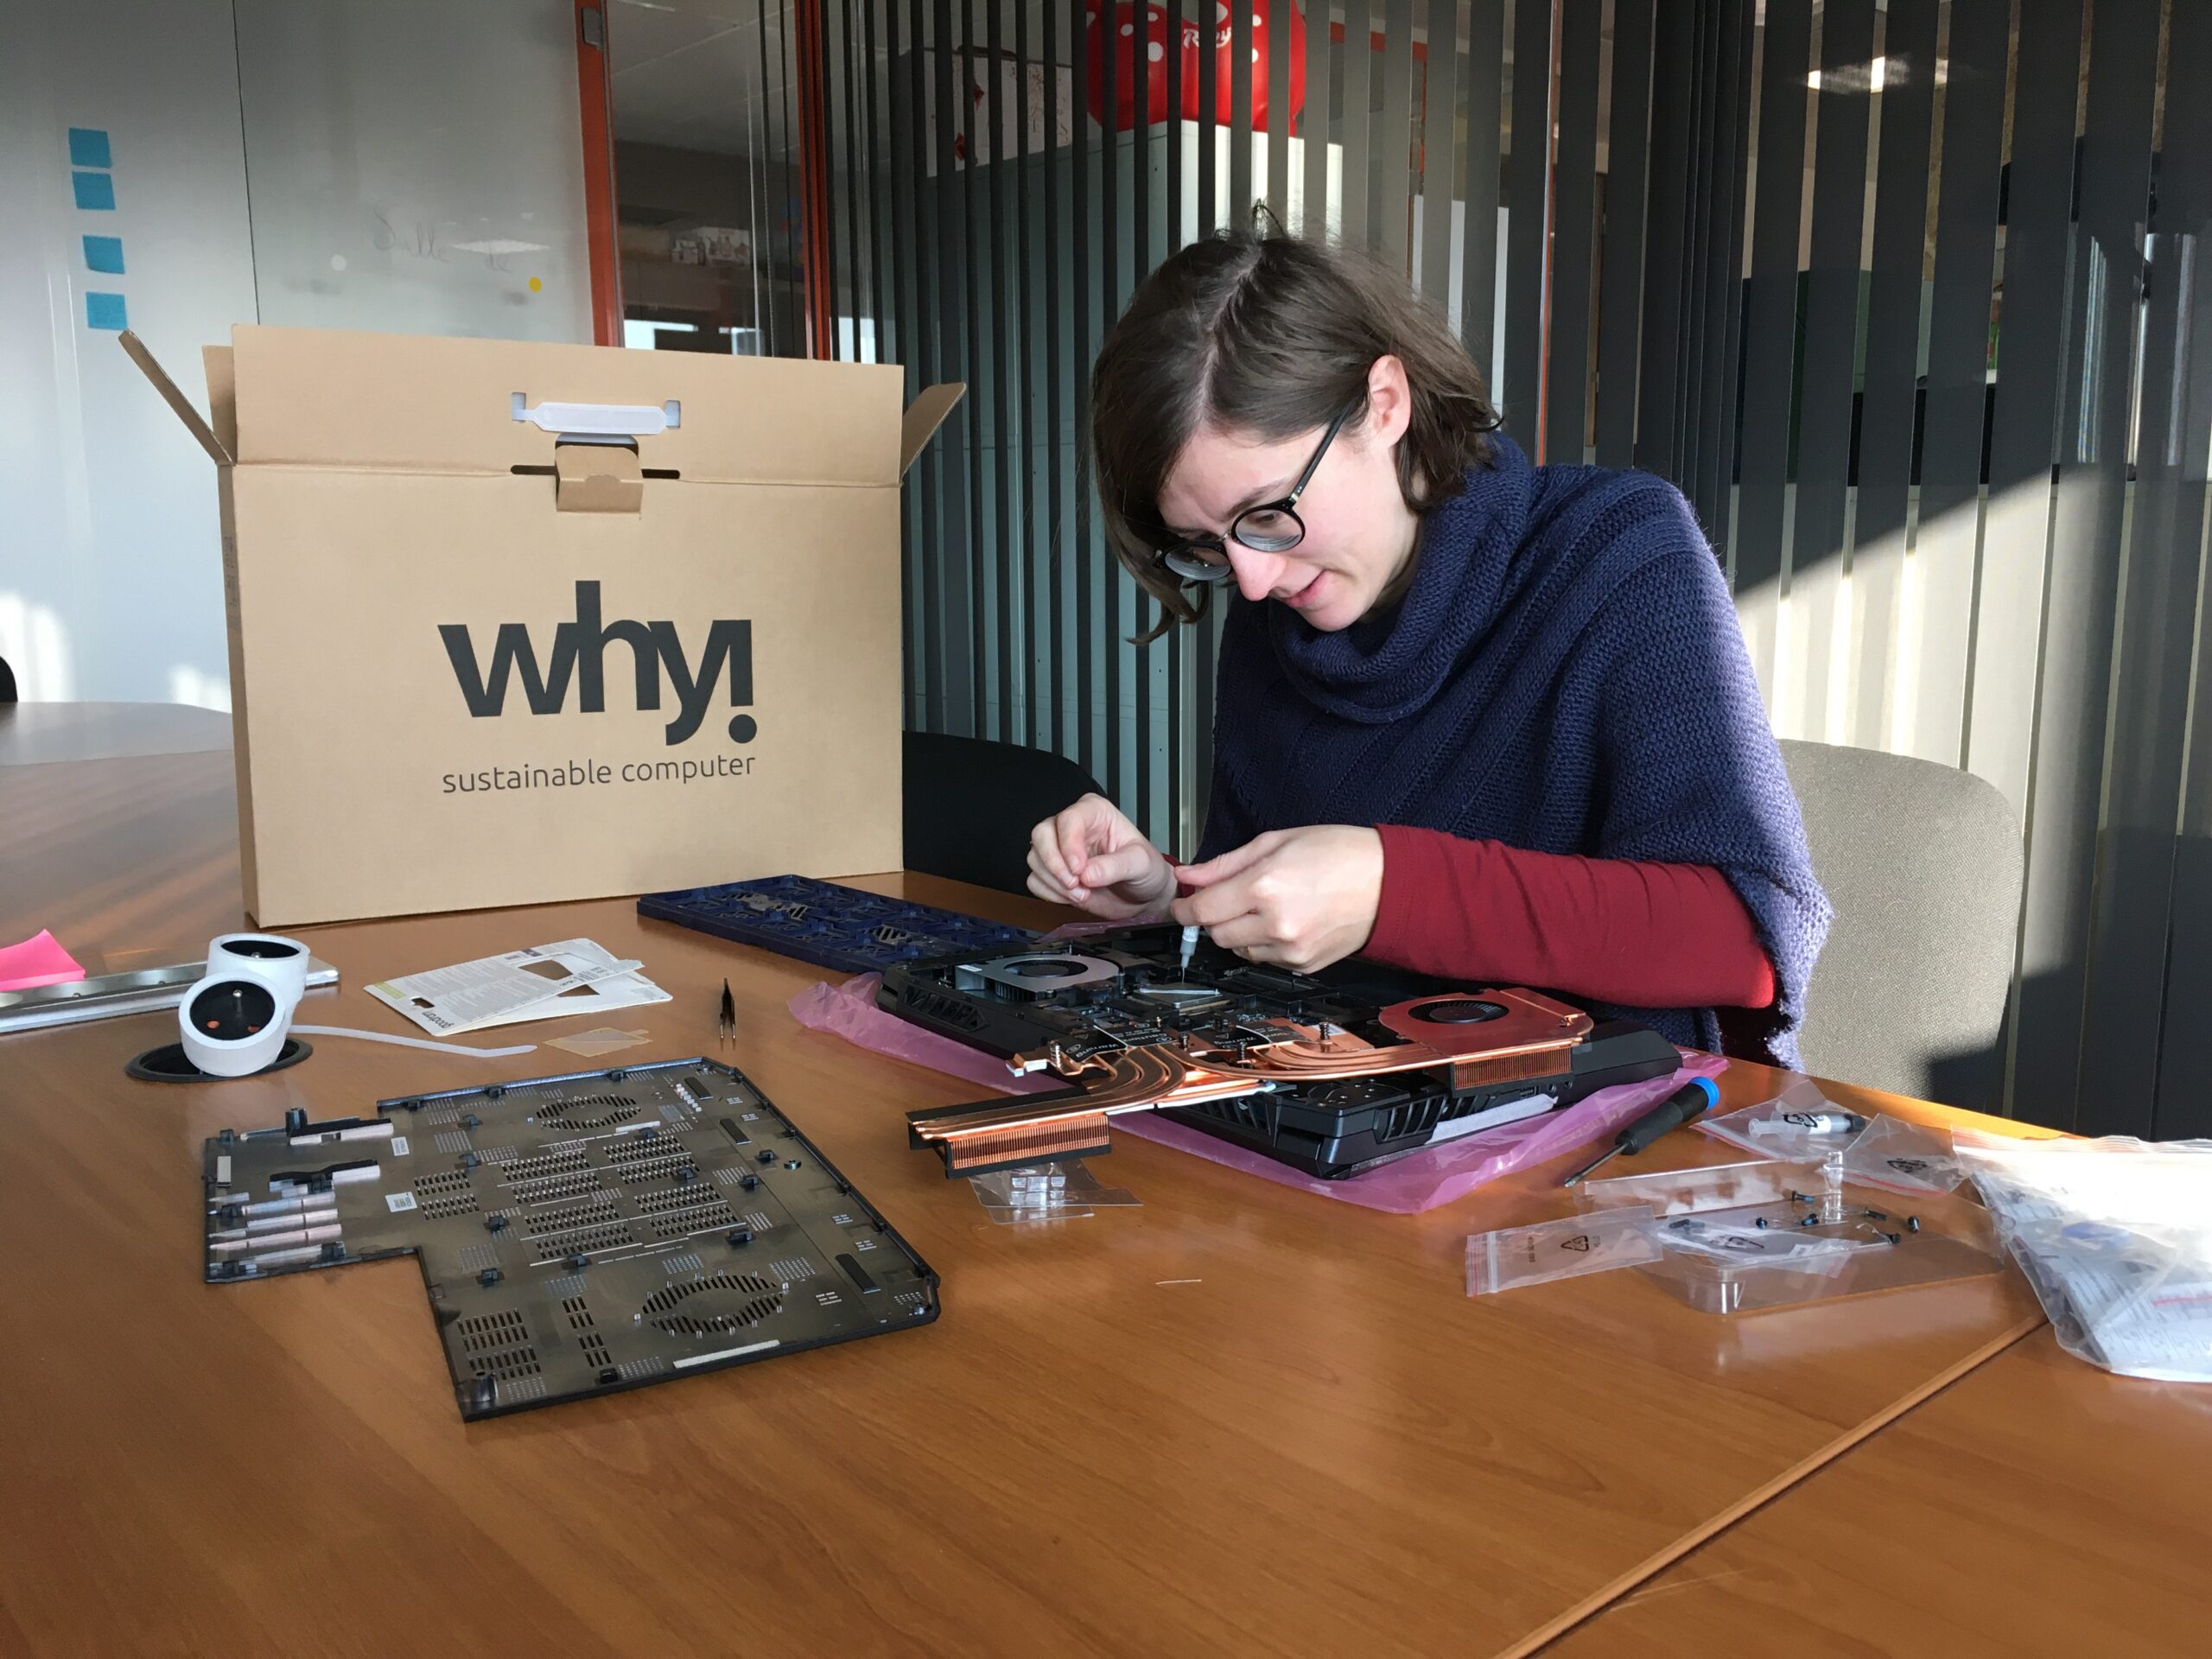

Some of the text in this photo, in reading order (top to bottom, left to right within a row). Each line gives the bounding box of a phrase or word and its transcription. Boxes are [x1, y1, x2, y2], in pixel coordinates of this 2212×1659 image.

[437, 580, 758, 746] why!
[443, 754, 756, 793] sustainable computer
[1076, 1043, 1119, 1058] Warning
